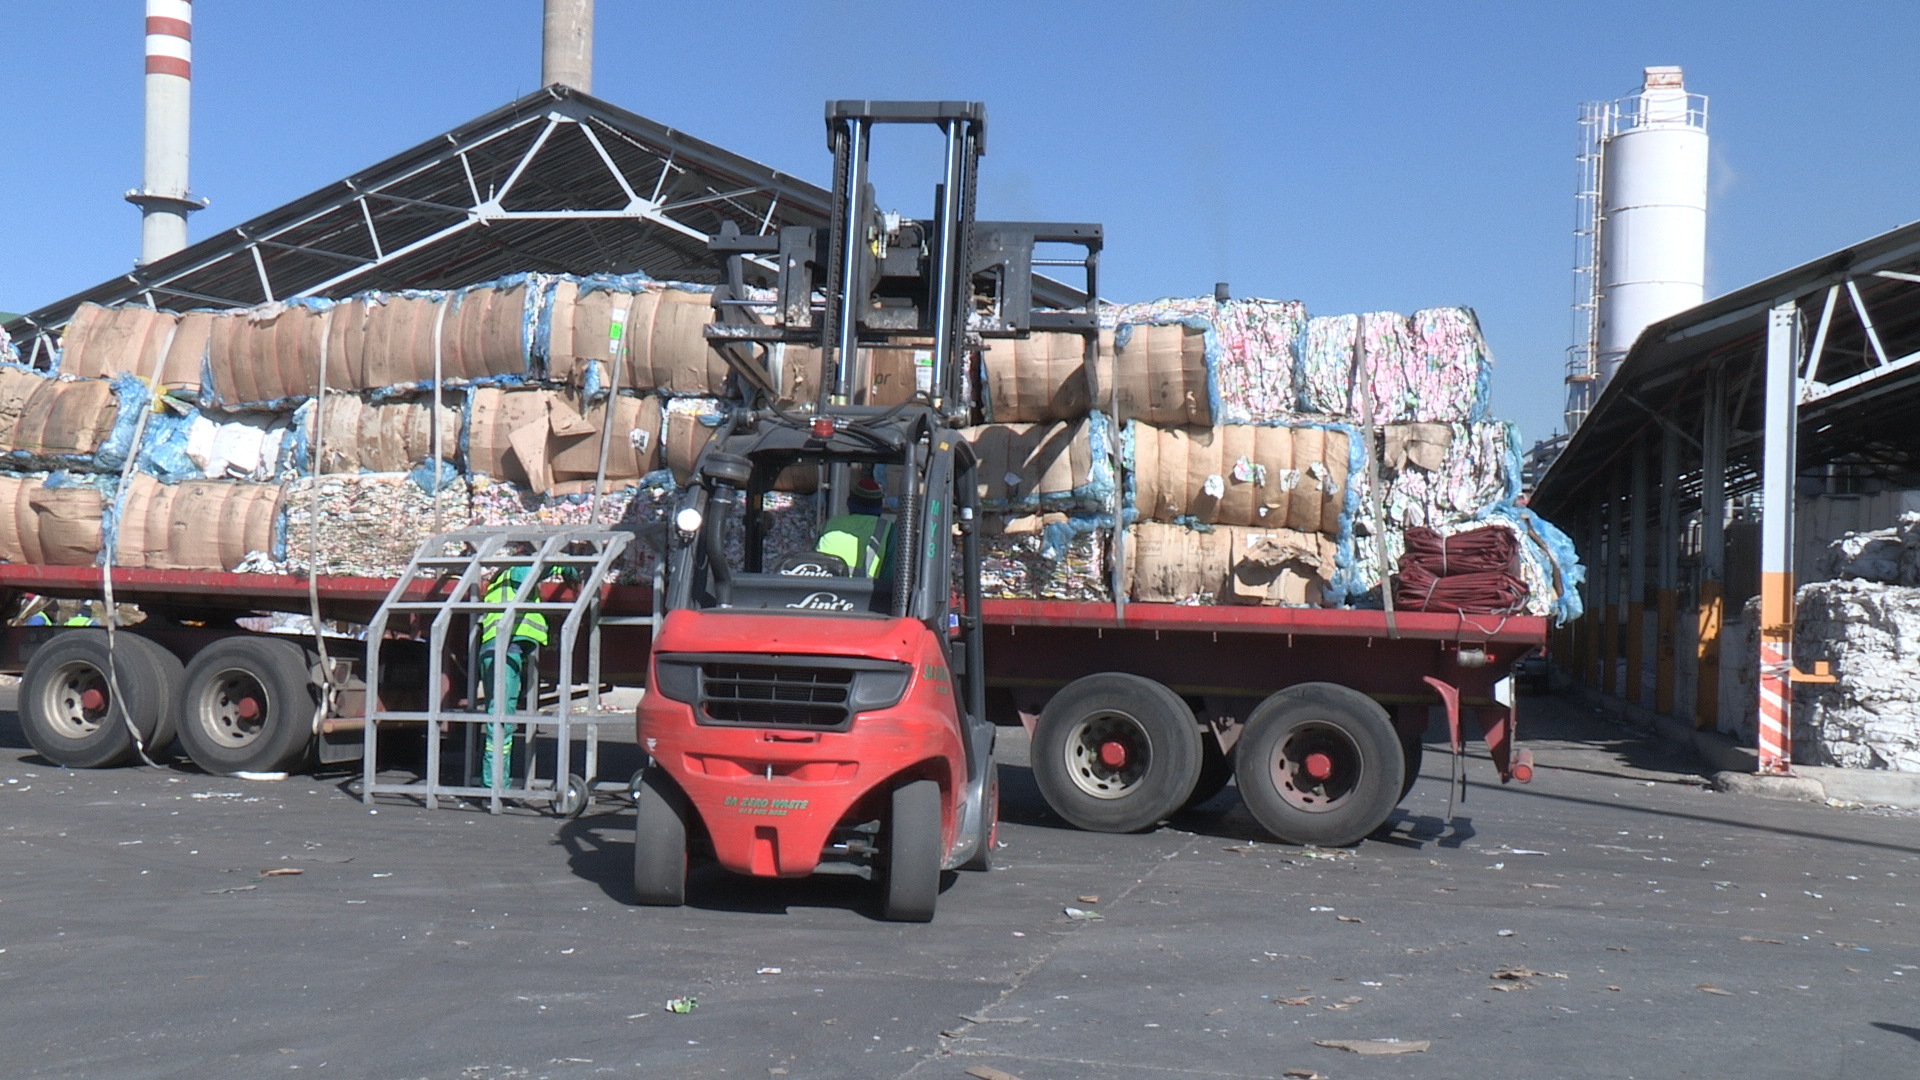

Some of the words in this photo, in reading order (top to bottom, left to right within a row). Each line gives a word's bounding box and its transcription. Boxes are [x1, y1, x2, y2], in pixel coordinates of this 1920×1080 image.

[781, 563, 833, 577] Linde
[785, 591, 854, 611] Linde
[740, 797, 769, 808] ZERO
[770, 799, 809, 810] WASTE
